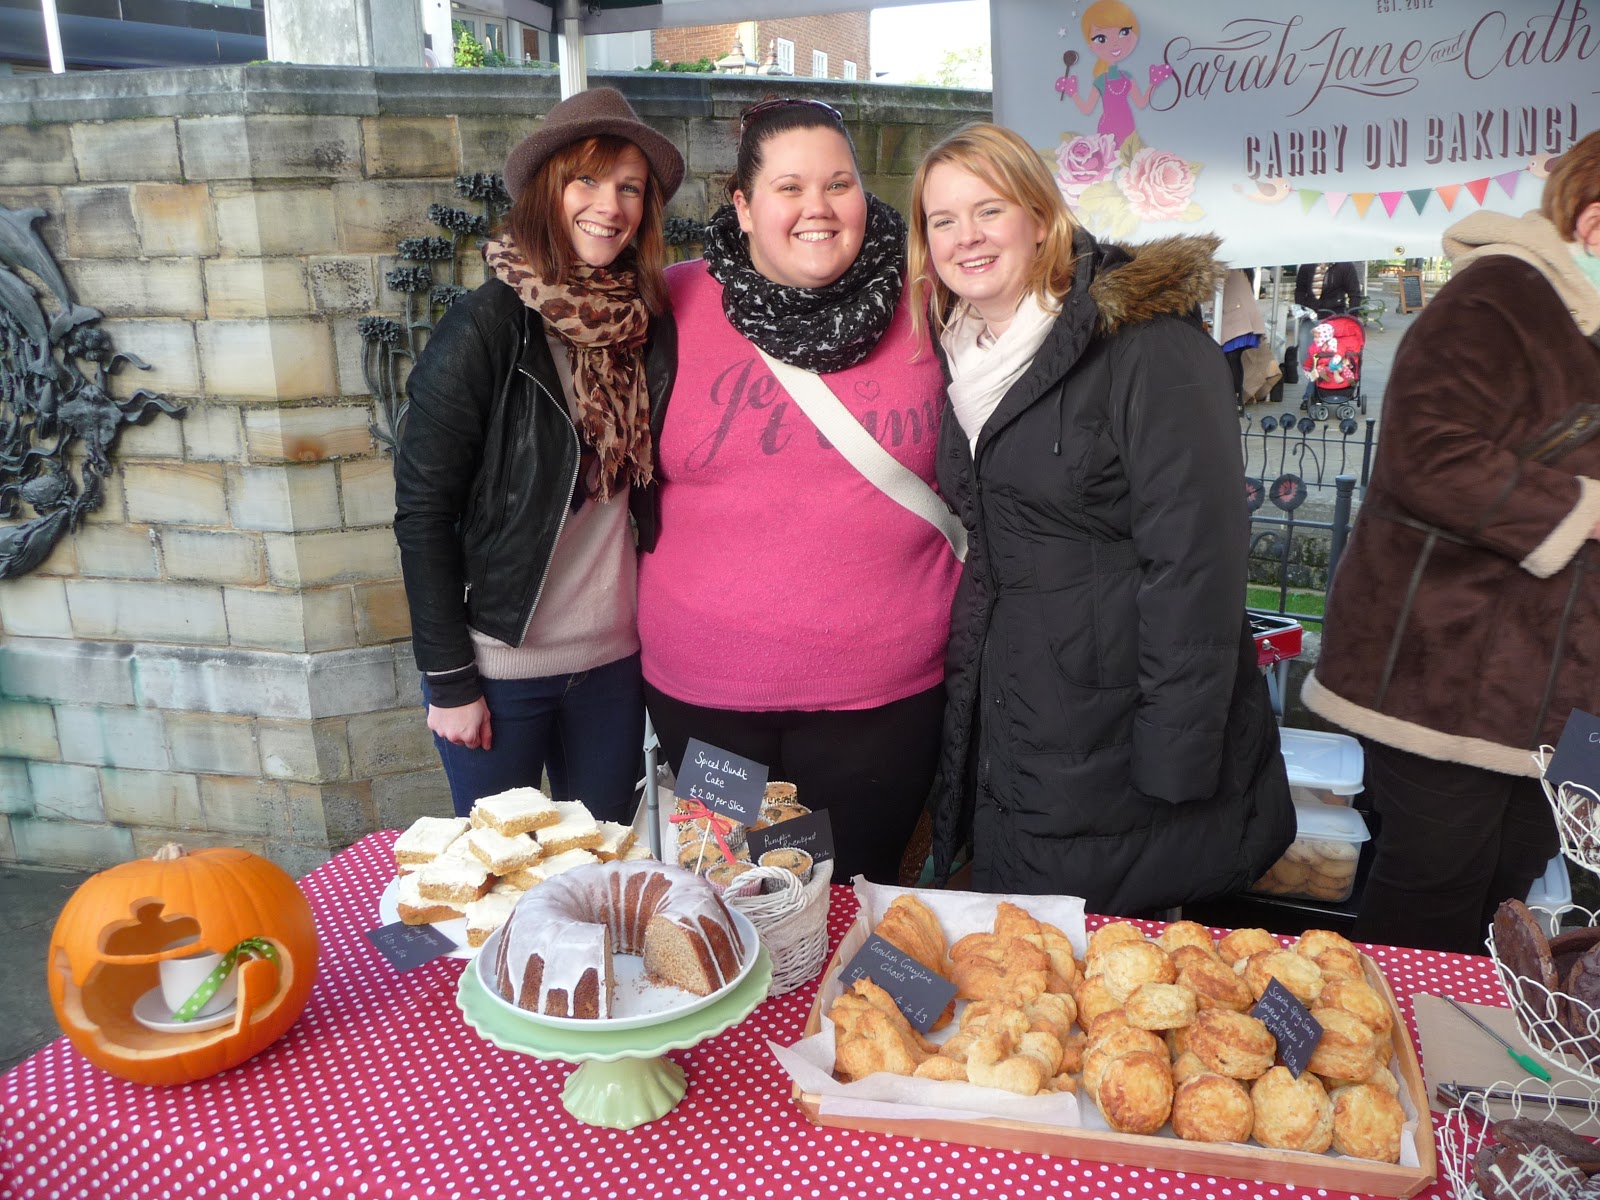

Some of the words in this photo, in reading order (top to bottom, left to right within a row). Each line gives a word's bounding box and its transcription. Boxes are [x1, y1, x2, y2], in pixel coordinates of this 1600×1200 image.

[1149, 14, 1424, 117] Sarah-Jane
[1430, 29, 1467, 65] and
[1242, 122, 1348, 180] CARRY
[1362, 116, 1408, 169] ON
[1424, 101, 1578, 165] BAKING!
[684, 357, 780, 472] Je
[695, 751, 720, 771] Spiced
[721, 760, 748, 781] Bundt
[705, 772, 725, 788] Cake
[689, 784, 715, 801] £2.00
[714, 796, 728, 808] per
[880, 962, 906, 983] Ghosts
[913, 1007, 928, 1024] £3
